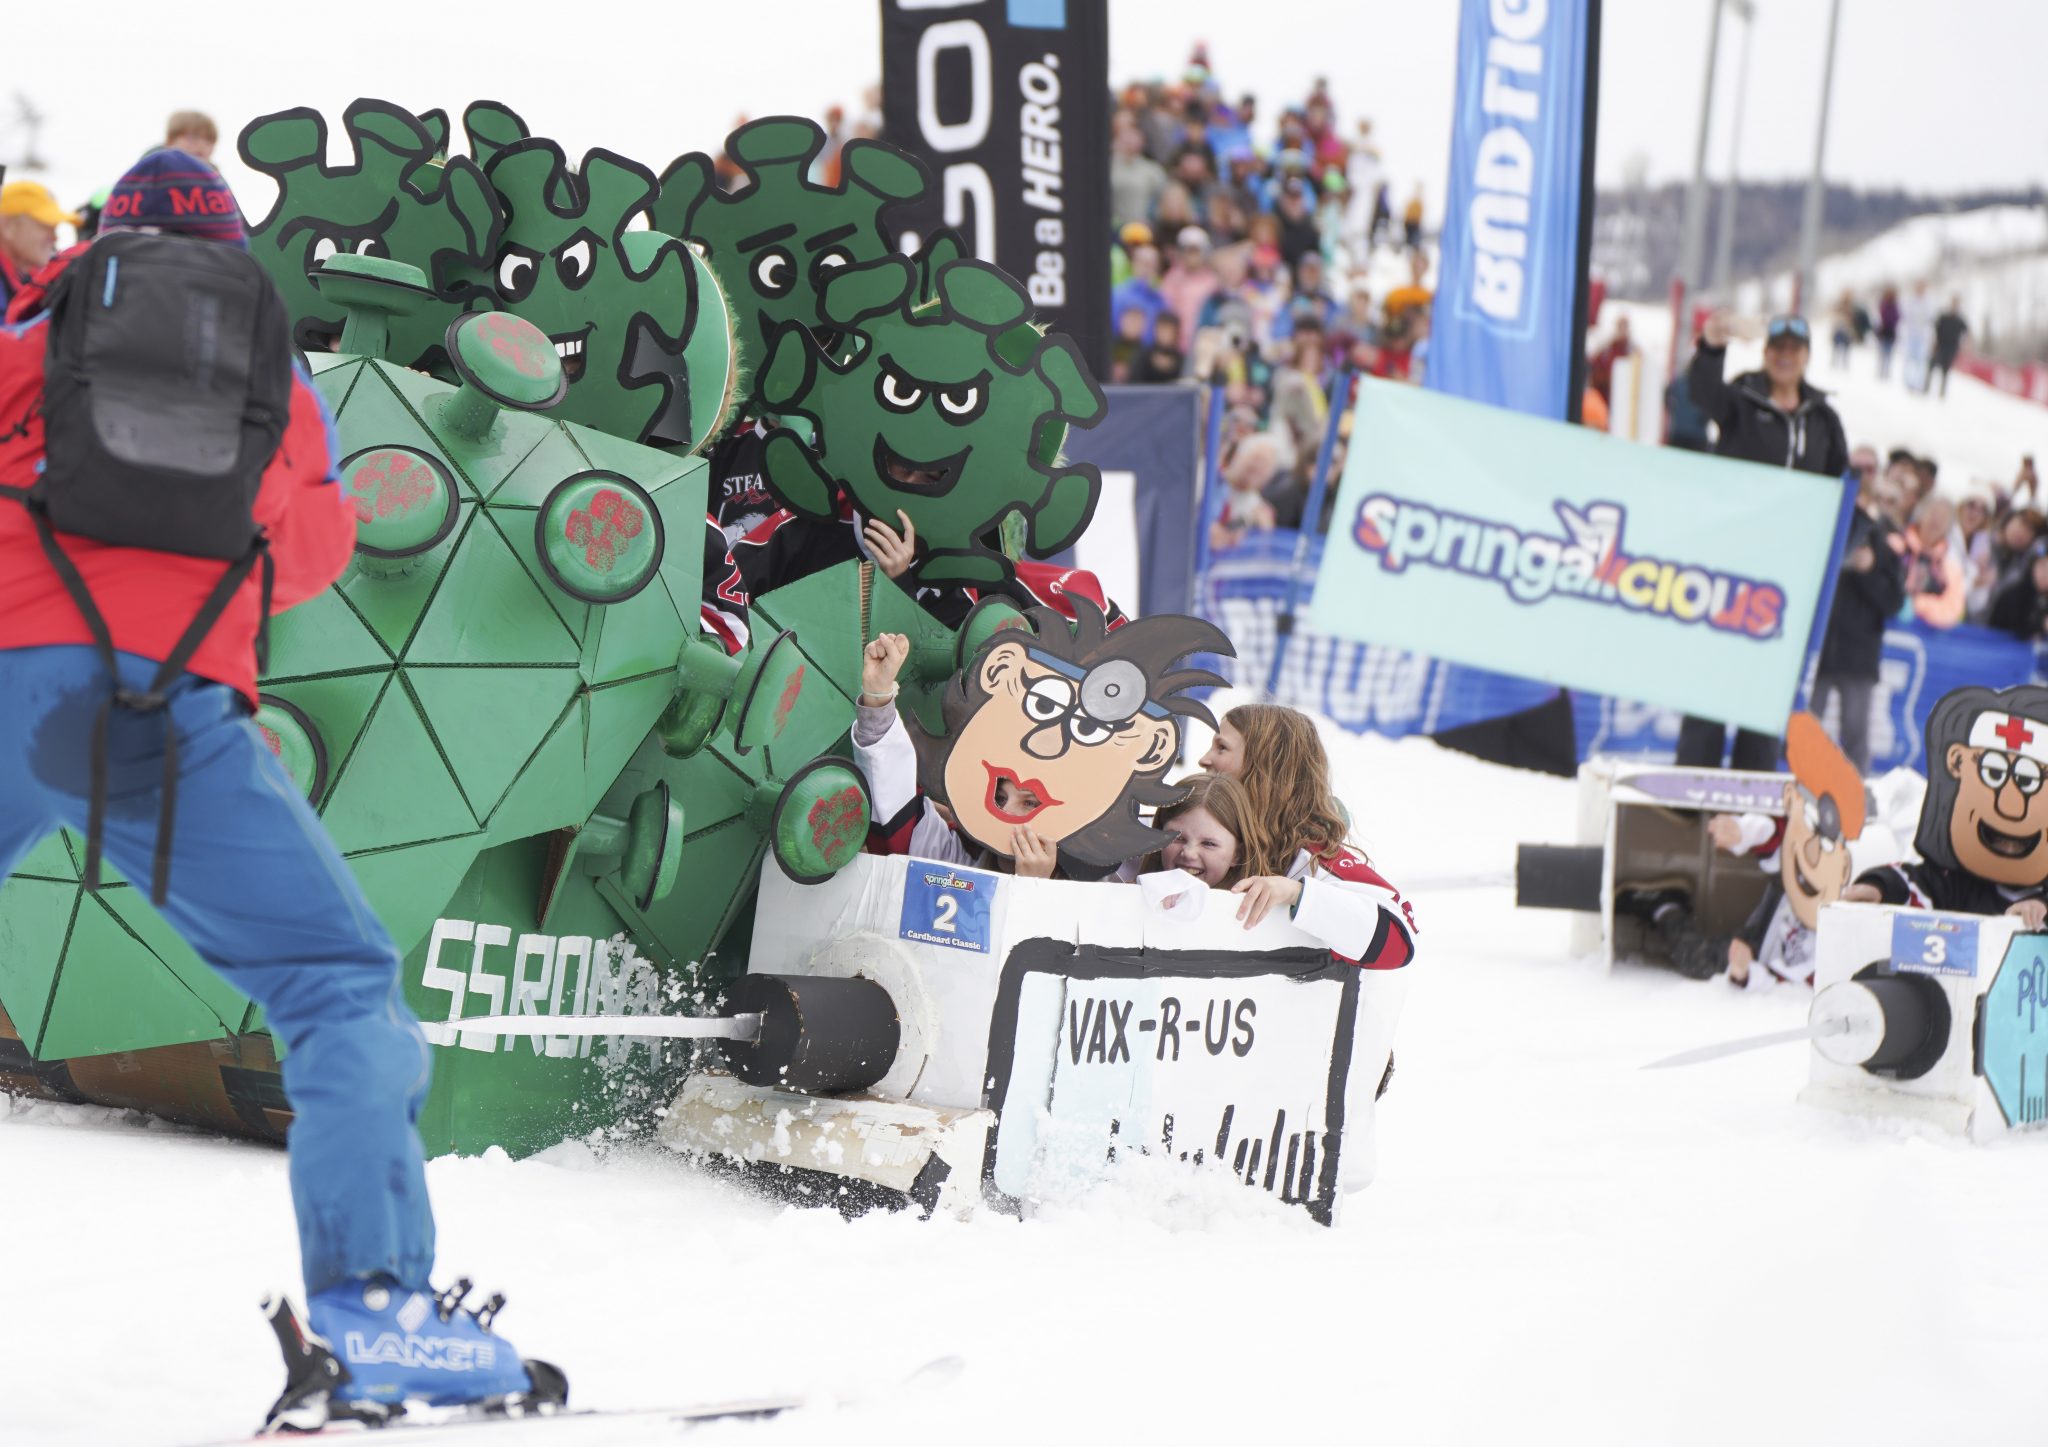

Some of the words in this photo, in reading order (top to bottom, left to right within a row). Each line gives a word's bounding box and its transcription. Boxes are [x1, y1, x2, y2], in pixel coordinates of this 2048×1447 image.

[1481, 0, 1548, 122] LIG
[1018, 53, 1063, 213] HERO.
[1035, 217, 1064, 246] a
[1470, 126, 1534, 320] BUD
[1027, 251, 1065, 306] Be
[722, 472, 766, 497] STEA
[933, 895, 957, 932] 2
[907, 930, 950, 944] Cardboard
[951, 938, 981, 949] Classic
[1922, 935, 1946, 964] 3
[345, 1331, 497, 1371] LANGE
